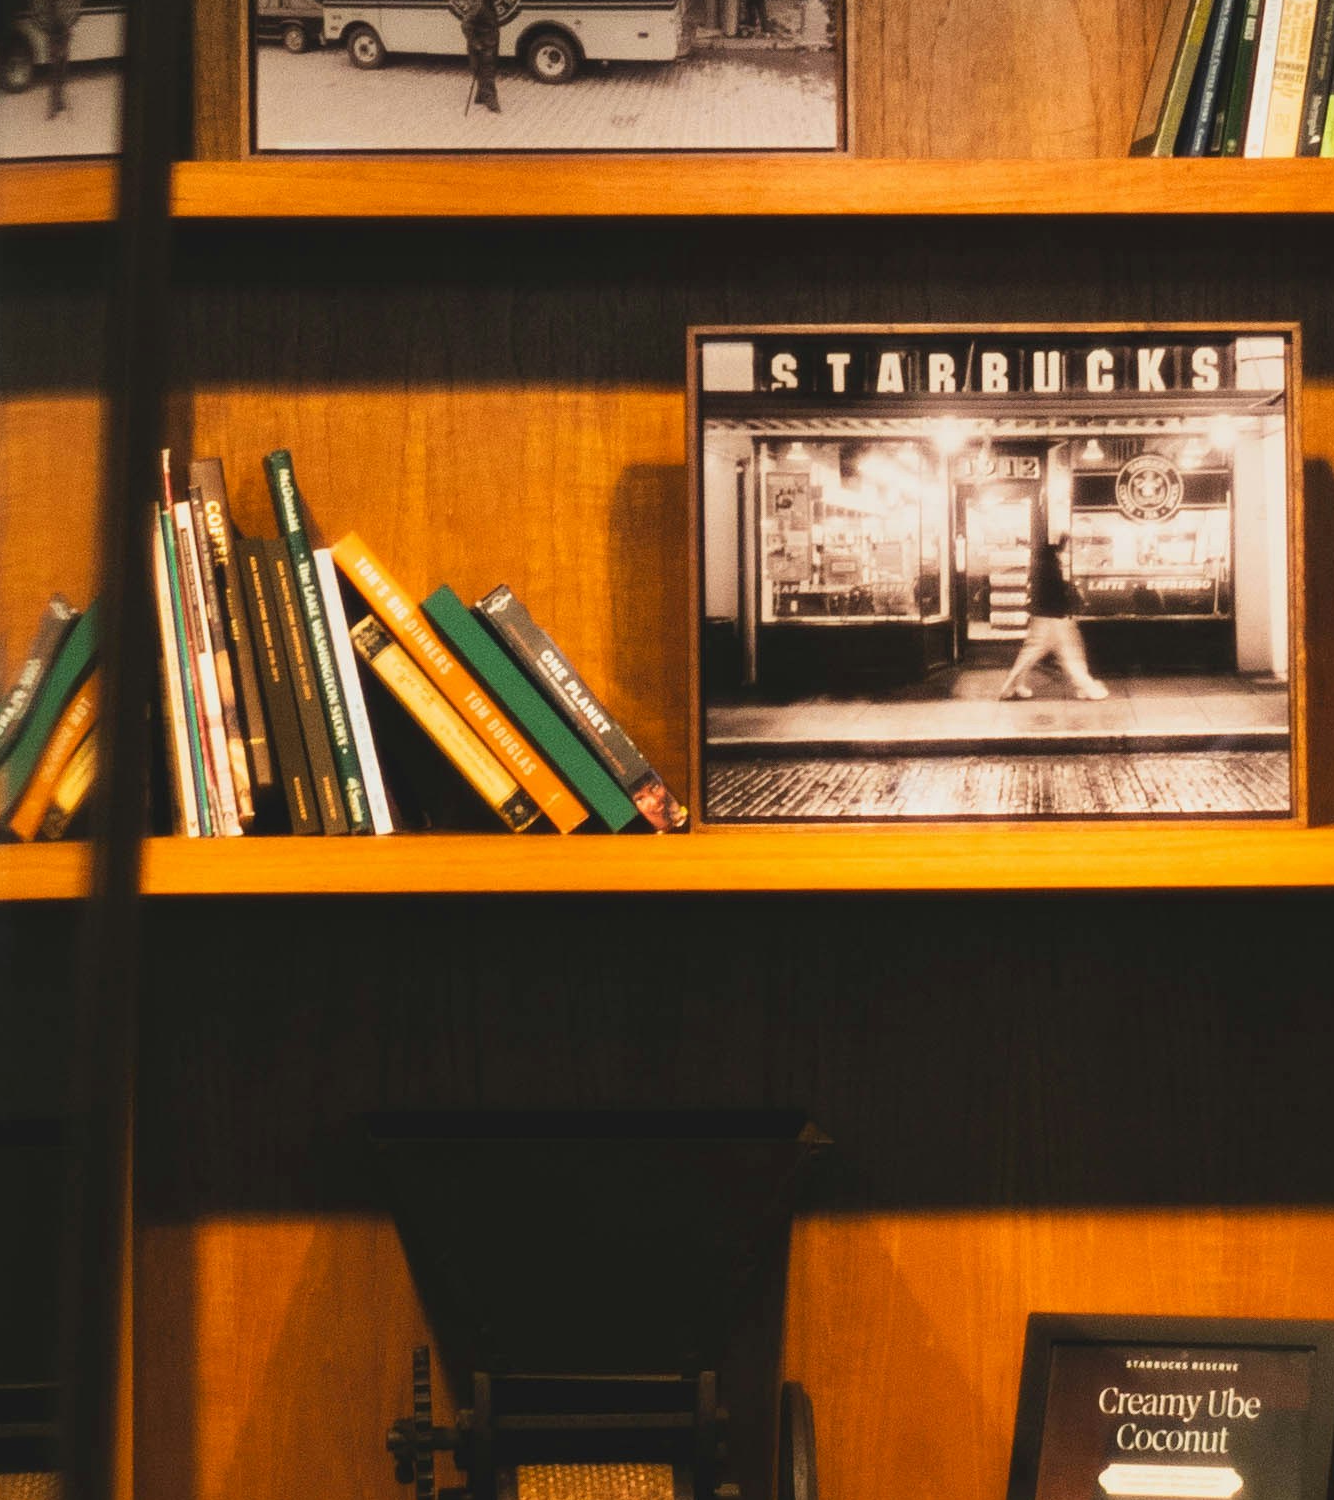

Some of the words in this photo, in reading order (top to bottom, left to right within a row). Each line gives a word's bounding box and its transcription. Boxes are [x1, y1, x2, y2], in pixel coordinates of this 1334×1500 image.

[770, 346, 1221, 393] STARBUCKS
[273, 467, 302, 533] McDonald
[295, 560, 314, 585] The
[300, 584, 321, 619] LAKE
[306, 618, 342, 705] WASHINGTON
[351, 554, 391, 601] TOM'S
[383, 593, 410, 623] BIG
[402, 614, 455, 678] DINNERS
[462, 687, 492, 721] TOM
[484, 714, 538, 780] DOUGLAS
[537, 646, 569, 683] ONE
[562, 677, 612, 737] PLANET
[326, 703, 351, 747] STORY
[1125, 1359, 1189, 1371] STARBUCKS
[1191, 1362, 1239, 1373] RESERVE
[1098, 1386, 1203, 1423] Creamy
[1208, 1387, 1262, 1420] Ube
[1116, 1422, 1230, 1455] Coconut
